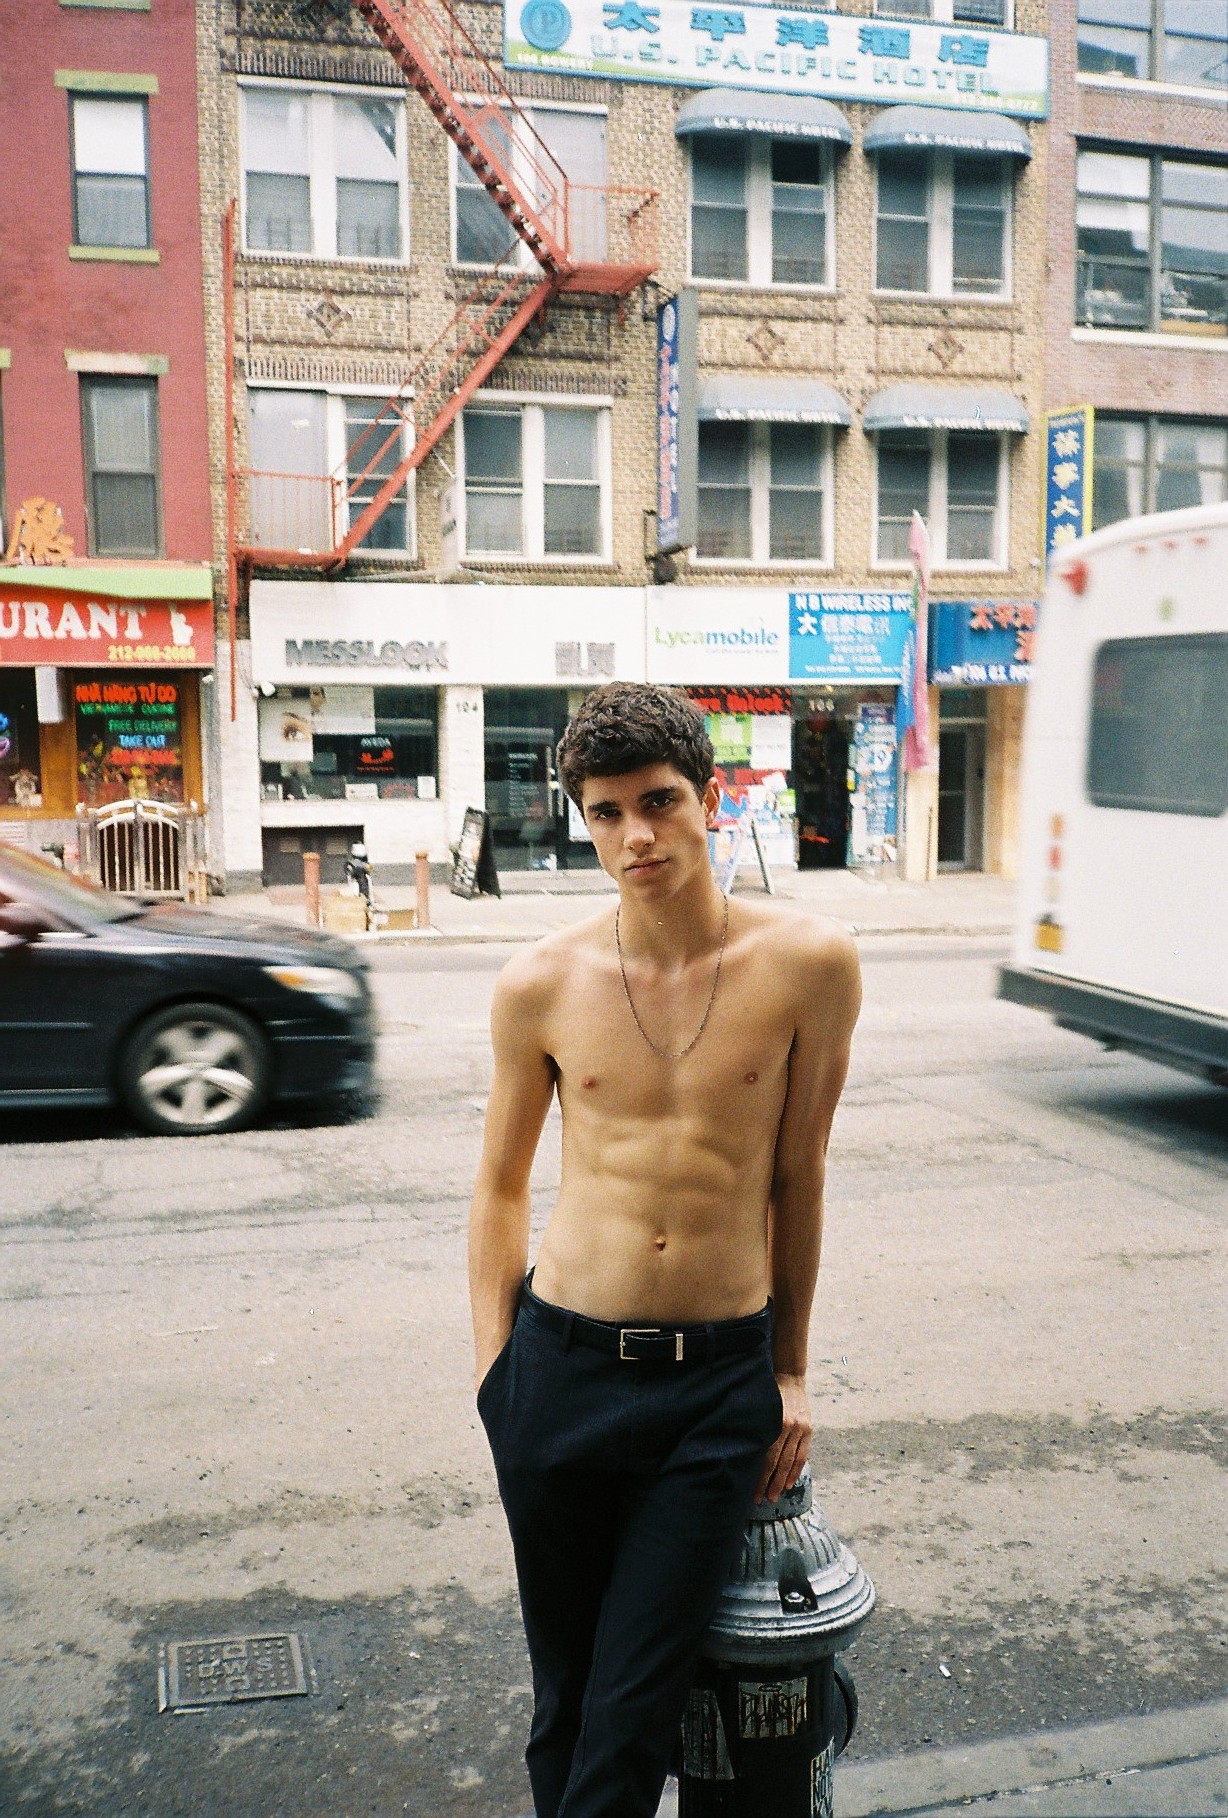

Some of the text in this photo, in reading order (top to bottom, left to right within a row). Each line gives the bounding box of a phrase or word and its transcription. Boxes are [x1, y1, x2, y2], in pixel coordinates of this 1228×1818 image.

[590, 34, 1000, 97] U.S. PACIFIC HOTEL
[821, 594, 891, 612] WIRELESS
[655, 626, 779, 648] Lycamobile
[285, 639, 449, 671] MESSLOOK
[119, 734, 167, 749] TAKE OUT
